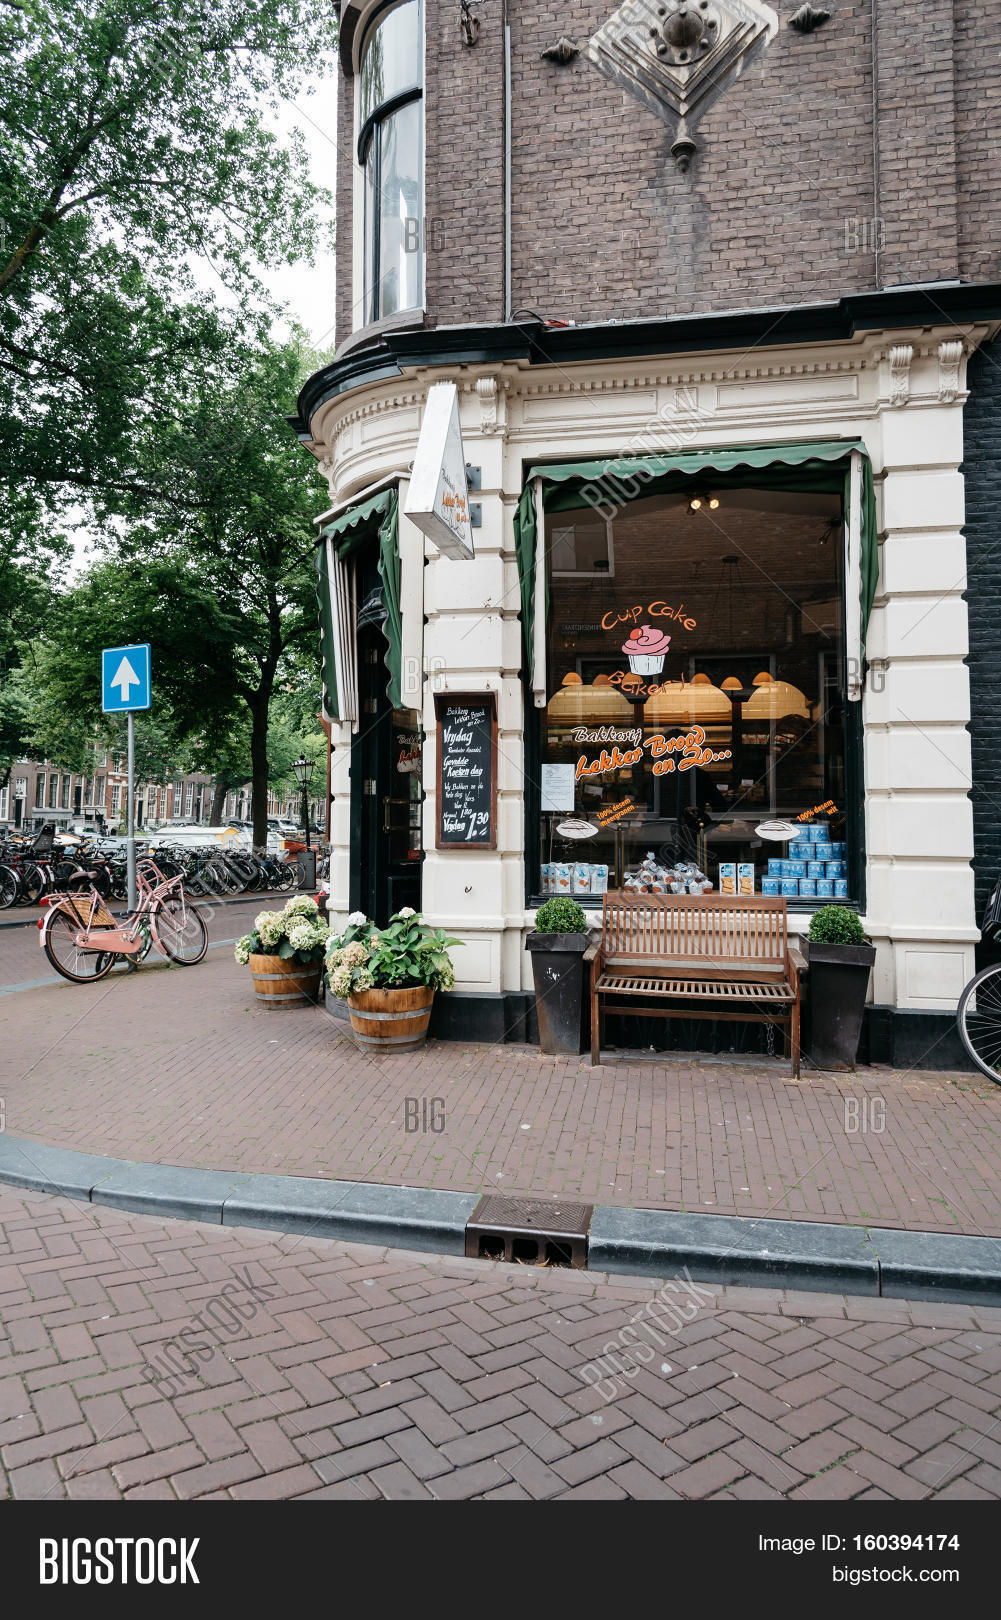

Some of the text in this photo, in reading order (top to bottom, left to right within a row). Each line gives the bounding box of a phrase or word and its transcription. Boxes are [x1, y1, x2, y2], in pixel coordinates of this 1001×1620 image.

[601, 601, 697, 631] Cup Cake
[571, 726, 643, 747] Bakkerij
[575, 725, 706, 781] Lekker Brood
[652, 758, 676, 777] en
[612, 797, 631, 811] desem
[796, 799, 834, 822] 100% desem
[826, 805, 838, 816] wit
